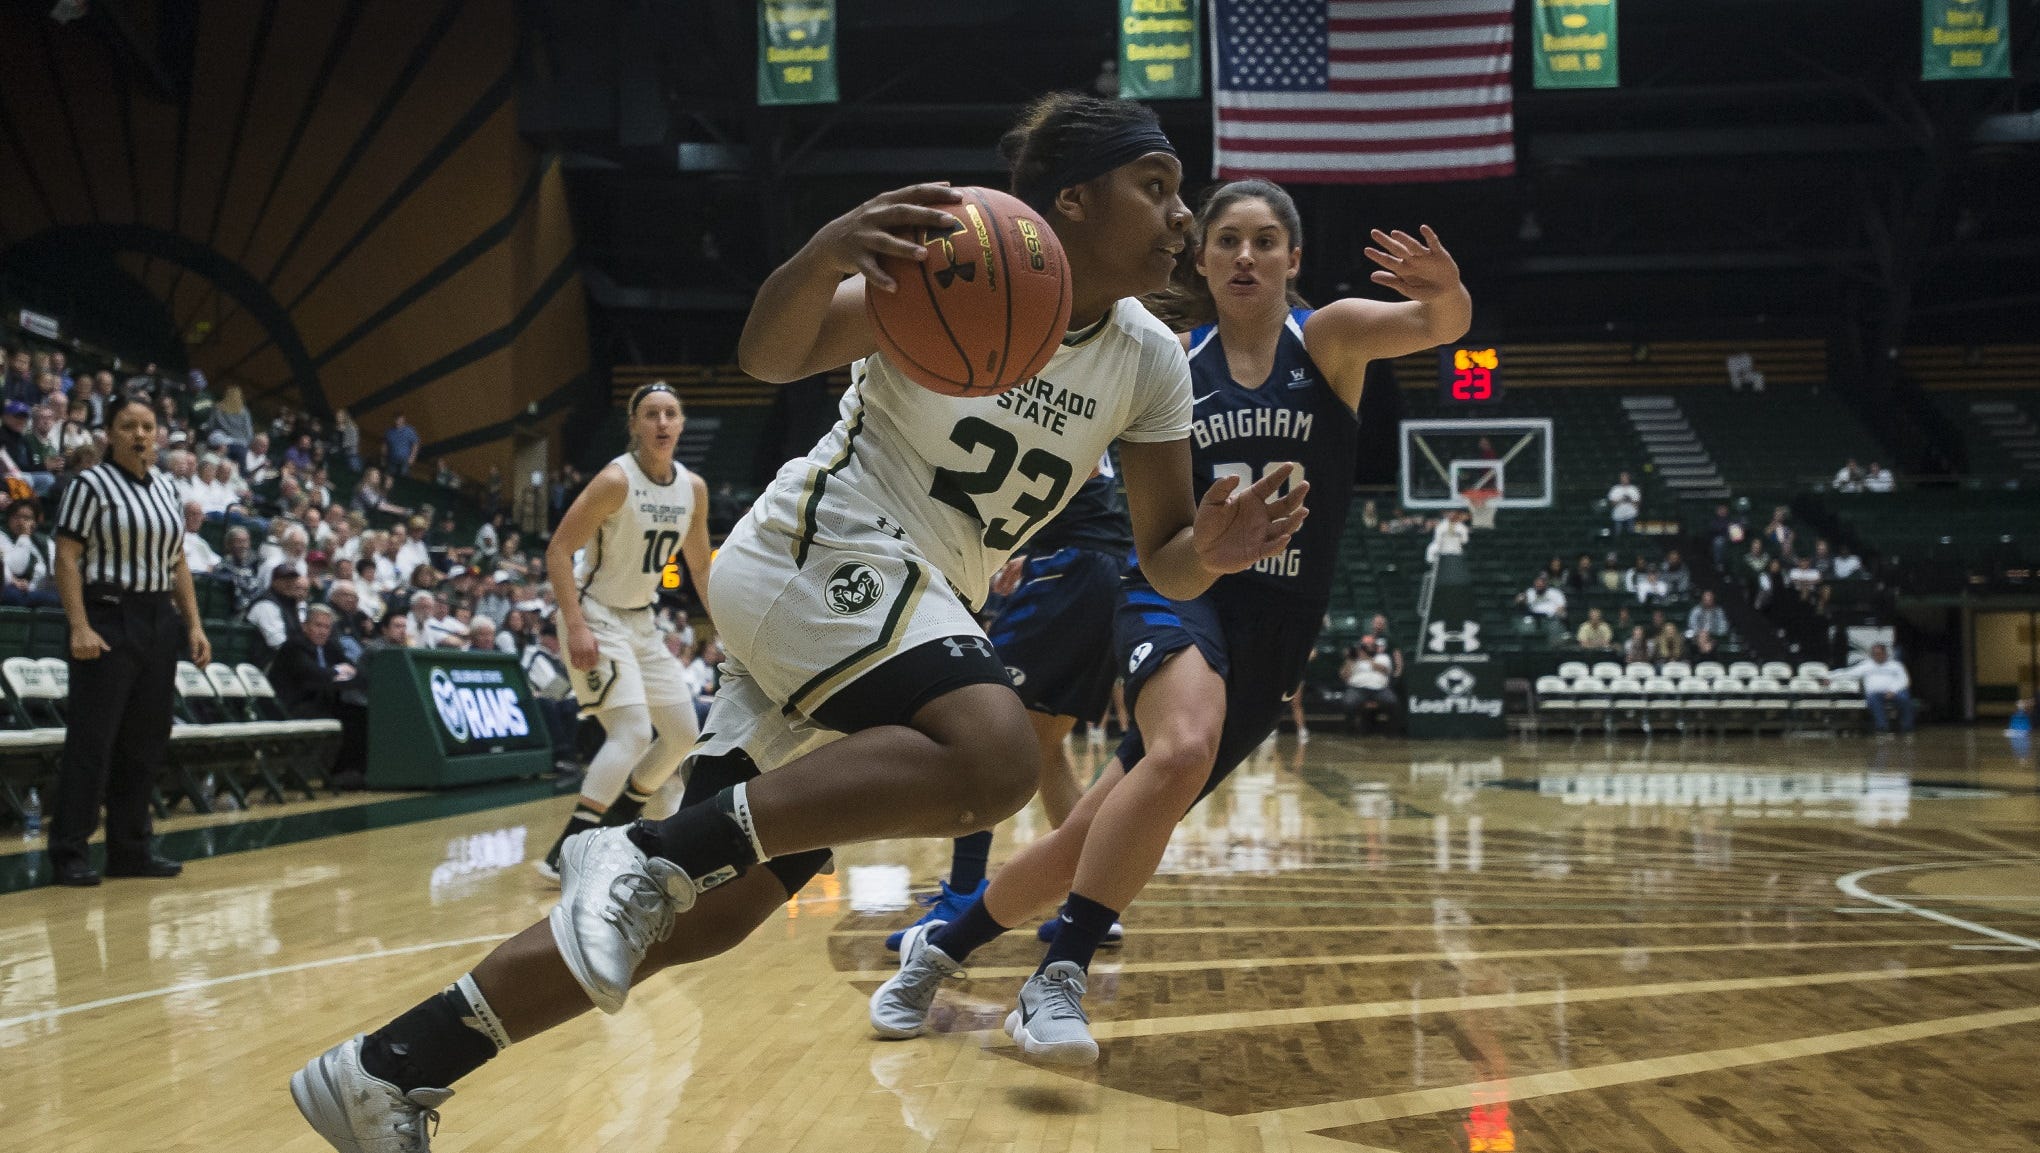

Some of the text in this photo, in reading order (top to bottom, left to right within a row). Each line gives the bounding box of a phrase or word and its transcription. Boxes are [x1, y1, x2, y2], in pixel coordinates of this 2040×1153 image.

[1019, 376, 1097, 420] ORADO
[1452, 367, 1492, 400] 23
[996, 390, 1068, 436] STATE
[1191, 408, 1314, 449] BRIGHAM
[928, 416, 1073, 550] 23
[642, 530, 680, 573] 10
[1255, 549, 1301, 577] UNG
